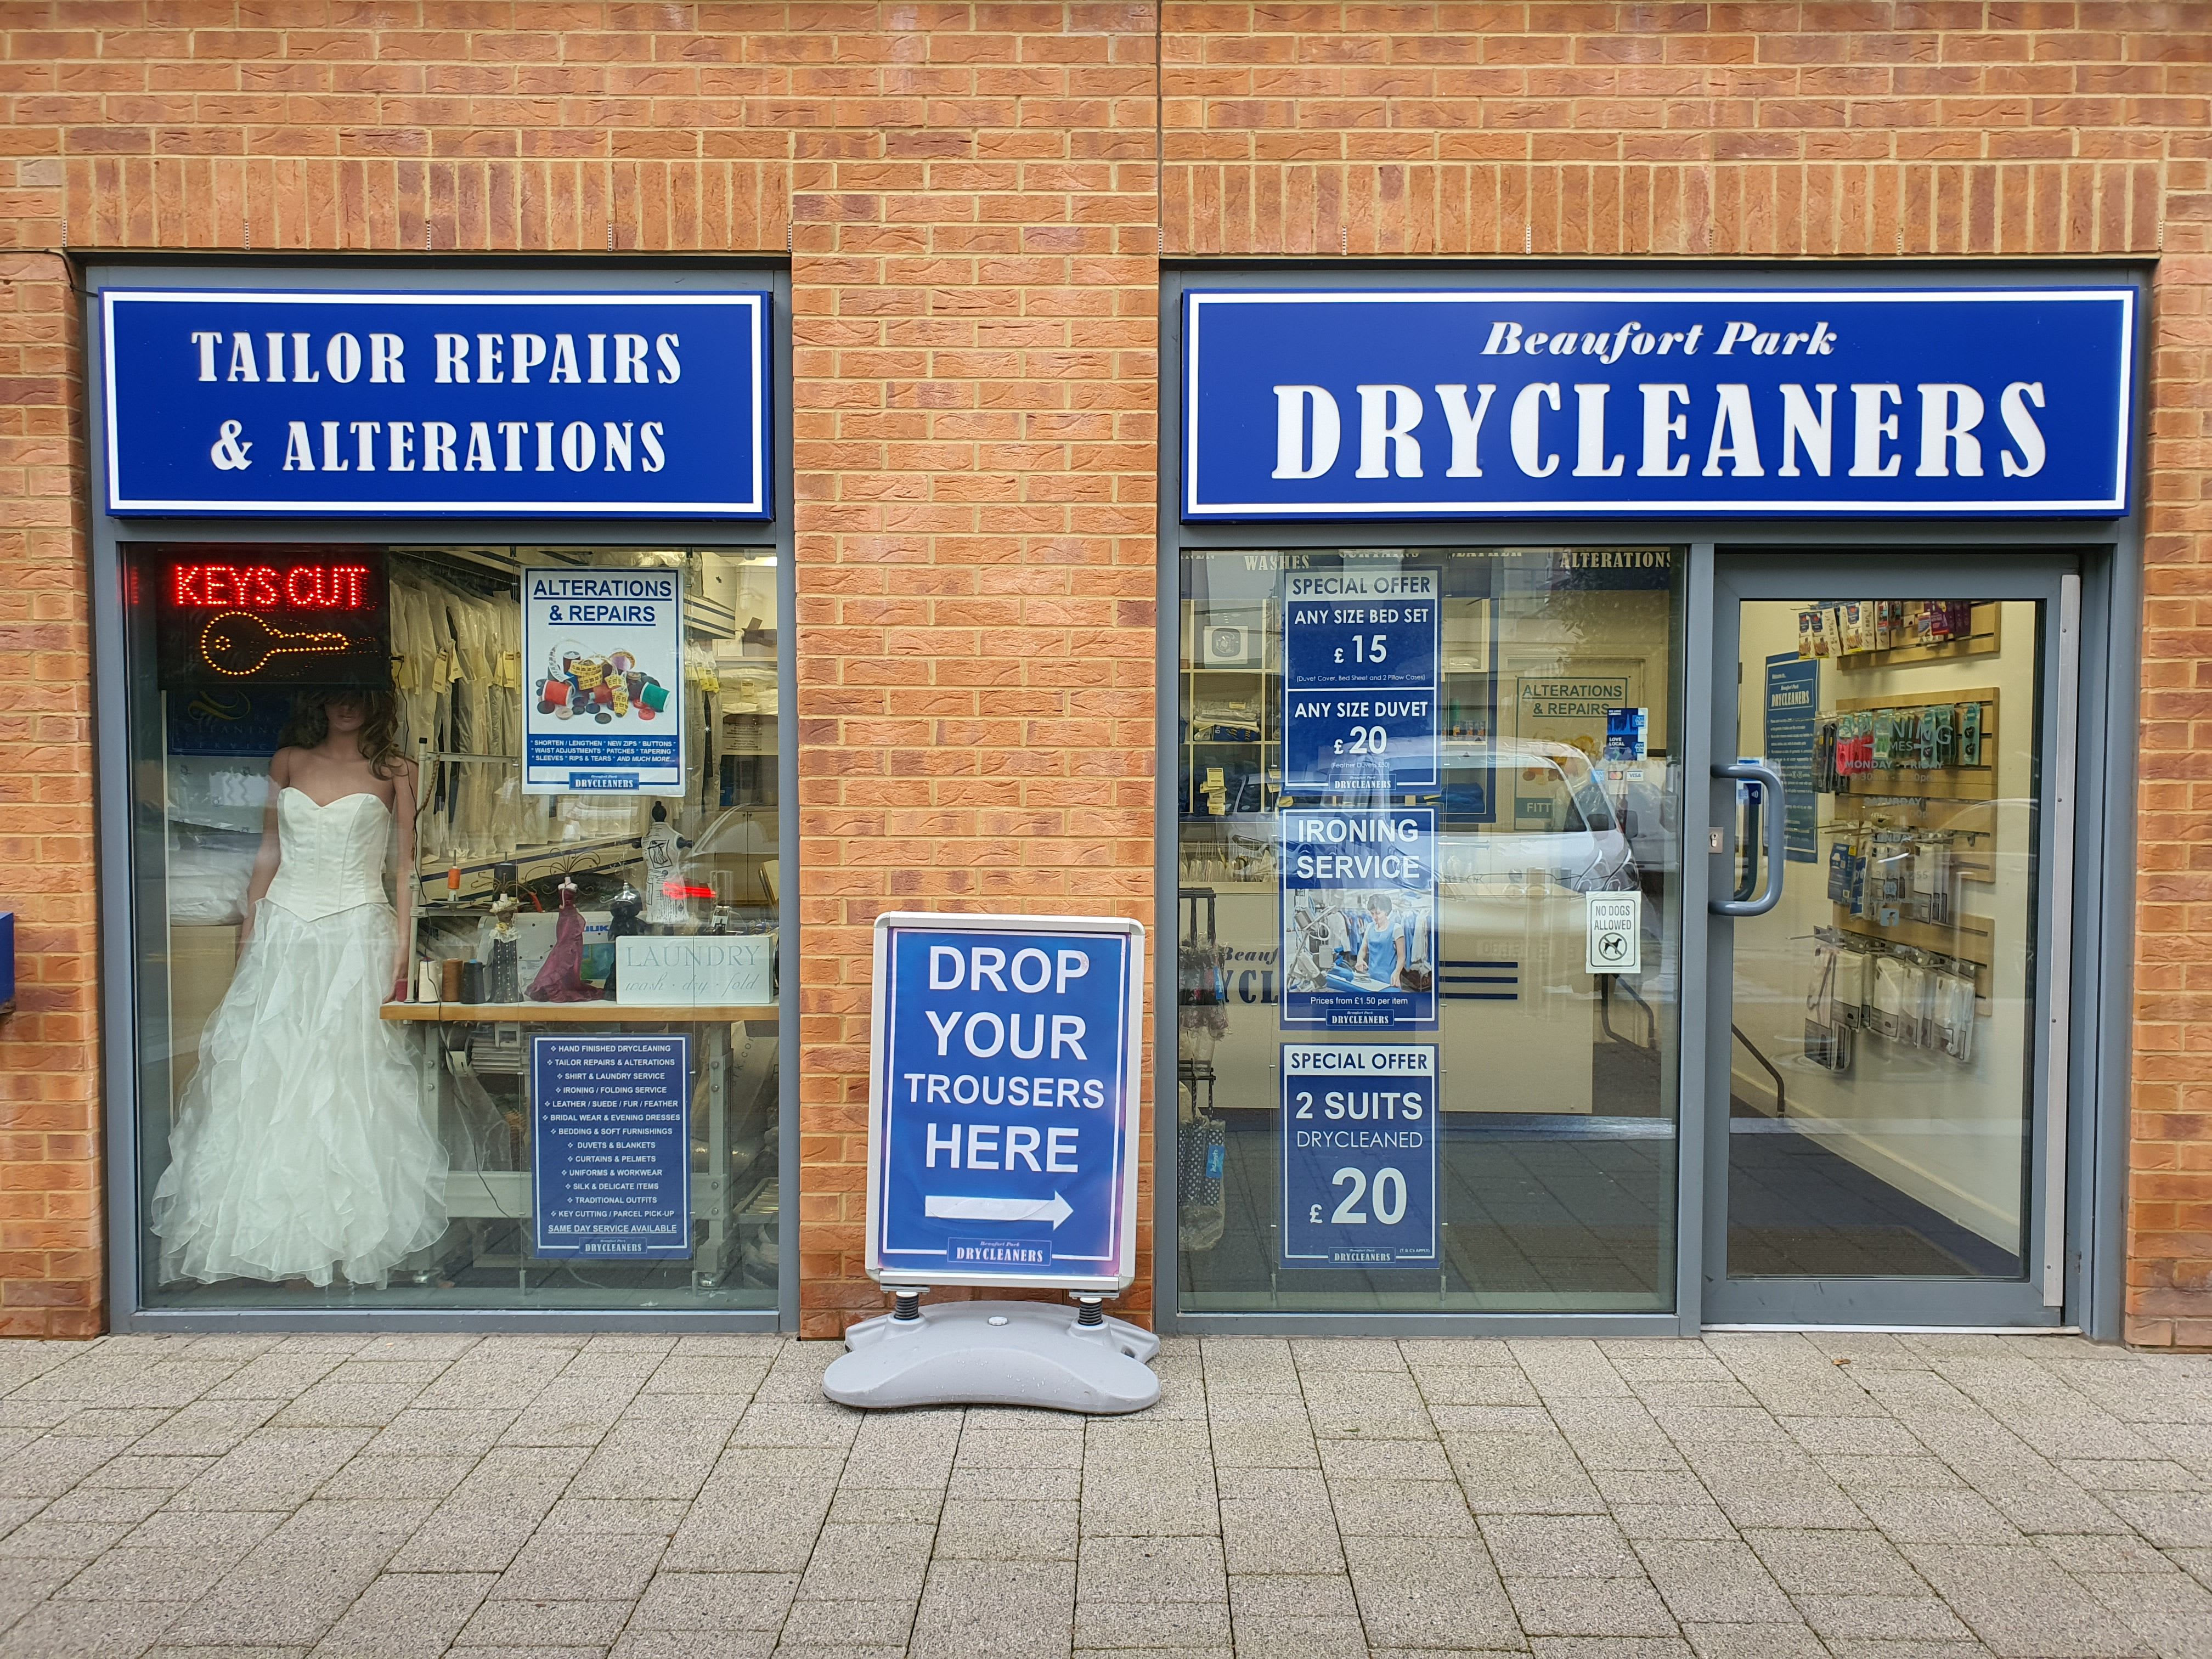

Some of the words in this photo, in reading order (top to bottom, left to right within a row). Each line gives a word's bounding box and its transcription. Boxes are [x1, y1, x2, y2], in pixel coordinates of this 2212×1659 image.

[1480, 320, 1704, 365] Beaufort
[1713, 320, 1837, 357] Park
[191, 331, 405, 383] TAILOR
[435, 332, 681, 384] REPAIRS
[1271, 381, 2046, 479] DRYCLEANERS
[211, 419, 253, 471] &
[283, 420, 666, 473] ALTERATIONS
[1244, 555, 1310, 570] WASHES
[176, 566, 277, 605] KEYS
[288, 566, 368, 606] CUT
[534, 580, 672, 596] ALTERATIONS
[1293, 578, 1368, 595] SPECIAL
[1374, 577, 1430, 593] OFFER
[550, 606, 562, 620] &
[569, 606, 655, 622] REPAIRS
[1295, 610, 1330, 624] ANY
[1334, 610, 1364, 624] SIZE
[1369, 609, 1398, 623] BED
[1404, 608, 1428, 623] SET
[1334, 648, 1344, 663] £
[1352, 635, 1387, 663] 15
[1522, 685, 1622, 696] ALTERATIONS
[1771, 690, 1809, 707] DRYCLEANERS
[1295, 703, 1331, 718] ANY
[1337, 702, 1369, 717] SIZE
[1375, 702, 1427, 716] DUVET
[1533, 704, 1542, 714] &
[1548, 703, 1609, 715] REPAIRS
[1334, 739, 1344, 754] £
[1349, 726, 1387, 754] 20
[575, 780, 633, 788] DRYCLEANERS
[1335, 780, 1391, 788] DRYCLEANERS
[1527, 803, 1551, 812] FITT
[1299, 819, 1418, 842] IRONING
[1297, 855, 1420, 878] SERVICE
[1596, 906, 1606, 916] NO
[1609, 906, 1630, 916] DOGS
[1594, 920, 1632, 930] ALLOWED
[626, 945, 761, 967] LAUNDRY
[1221, 946, 1279, 965] Beauf
[929, 946, 1089, 994] DROP
[625, 972, 667, 991] wash
[682, 975, 708, 995] dry
[721, 973, 760, 997] fold
[926, 1011, 1087, 1060] YOUR
[1291, 1053, 1365, 1069] SPECIAL
[1372, 1053, 1427, 1069] OFFER
[905, 1074, 1104, 1109] TROUSERS
[1296, 1092, 1313, 1119] 2
[1325, 1092, 1423, 1120] SUITS
[926, 1123, 1079, 1172] HERE
[1297, 1131, 1423, 1148] DRYCLEANED
[1310, 1204, 1323, 1223] £
[1331, 1167, 1407, 1224] 20
[956, 1247, 1043, 1262] DRYCLEANERS
